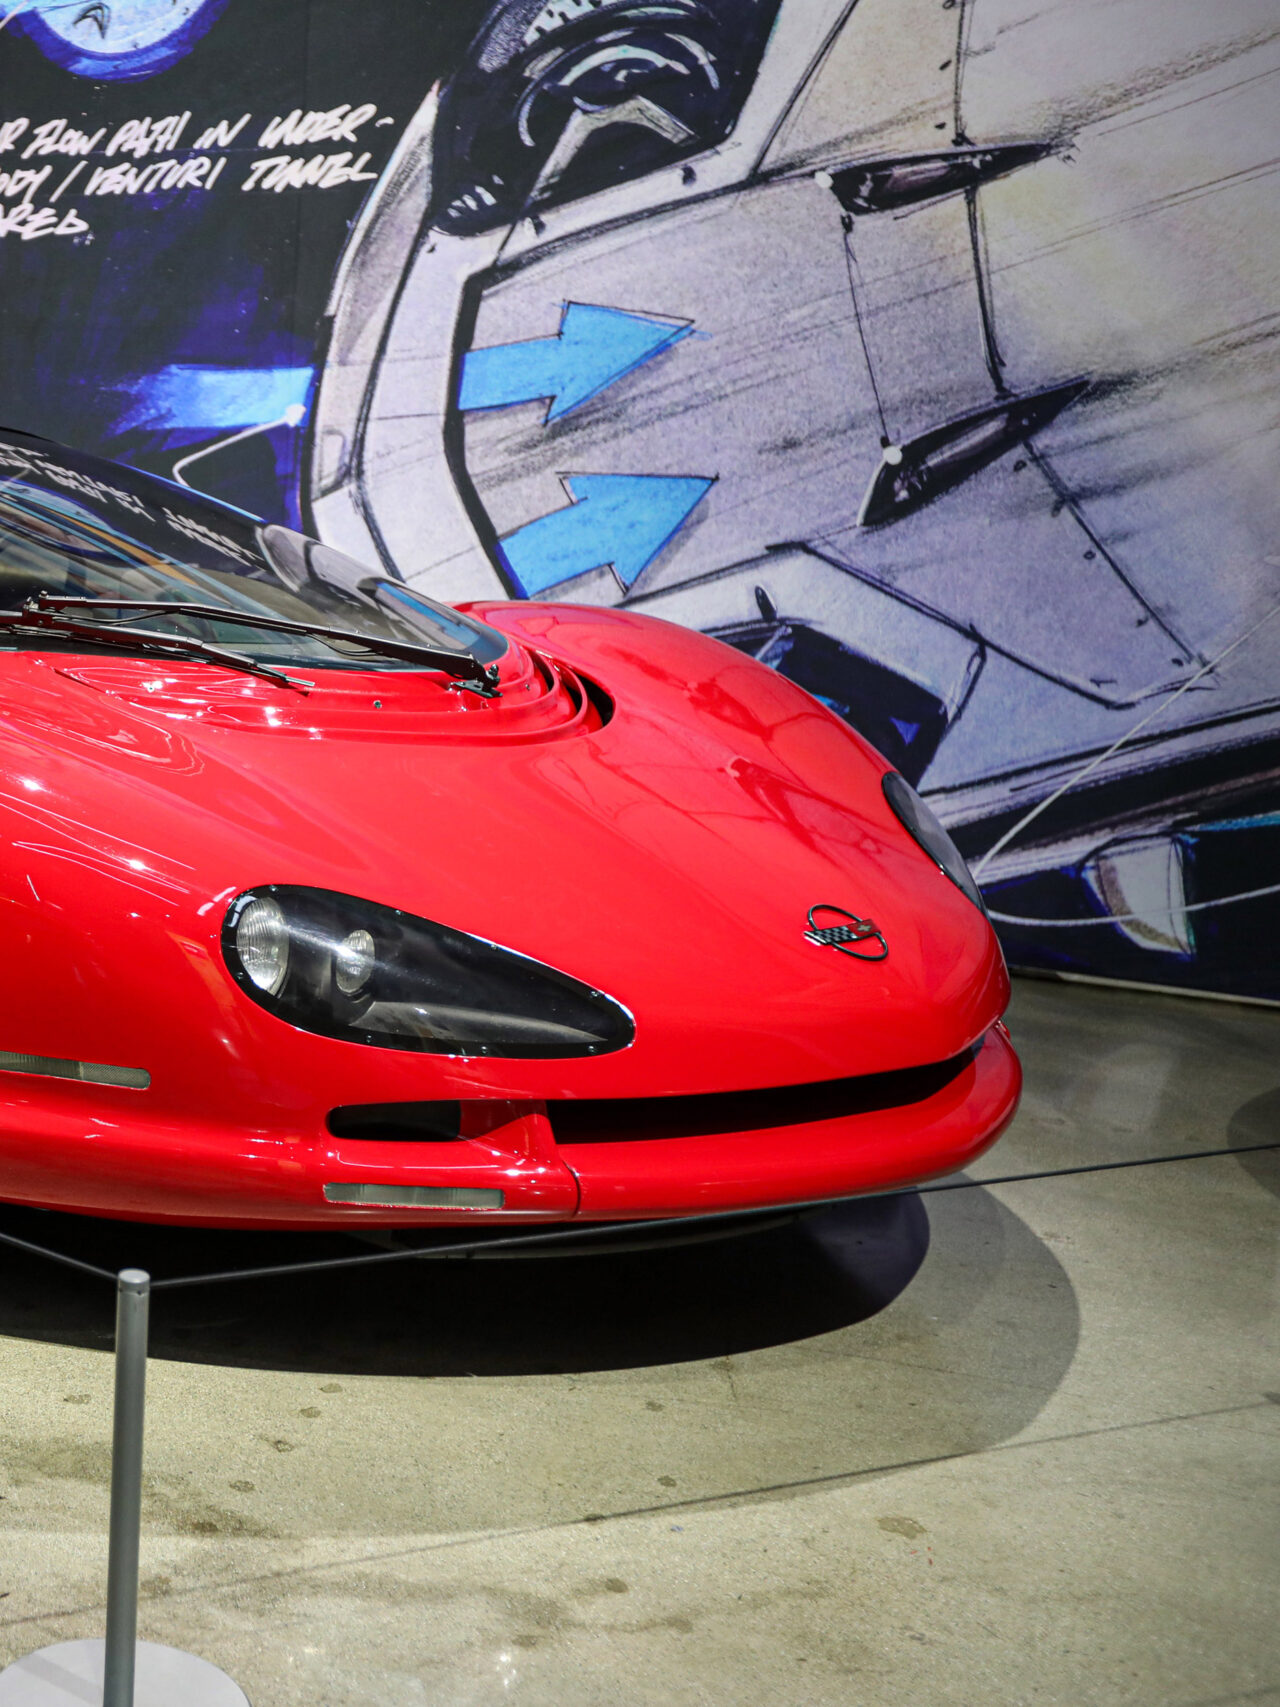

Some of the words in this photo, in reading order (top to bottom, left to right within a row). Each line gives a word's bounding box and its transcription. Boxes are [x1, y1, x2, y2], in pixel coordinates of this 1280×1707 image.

[21, 118, 107, 159] FLOW
[105, 110, 192, 158] PATH
[193, 113, 252, 149] IN
[84, 156, 227, 196] VENTURI
[241, 151, 378, 193] TUNNEL
